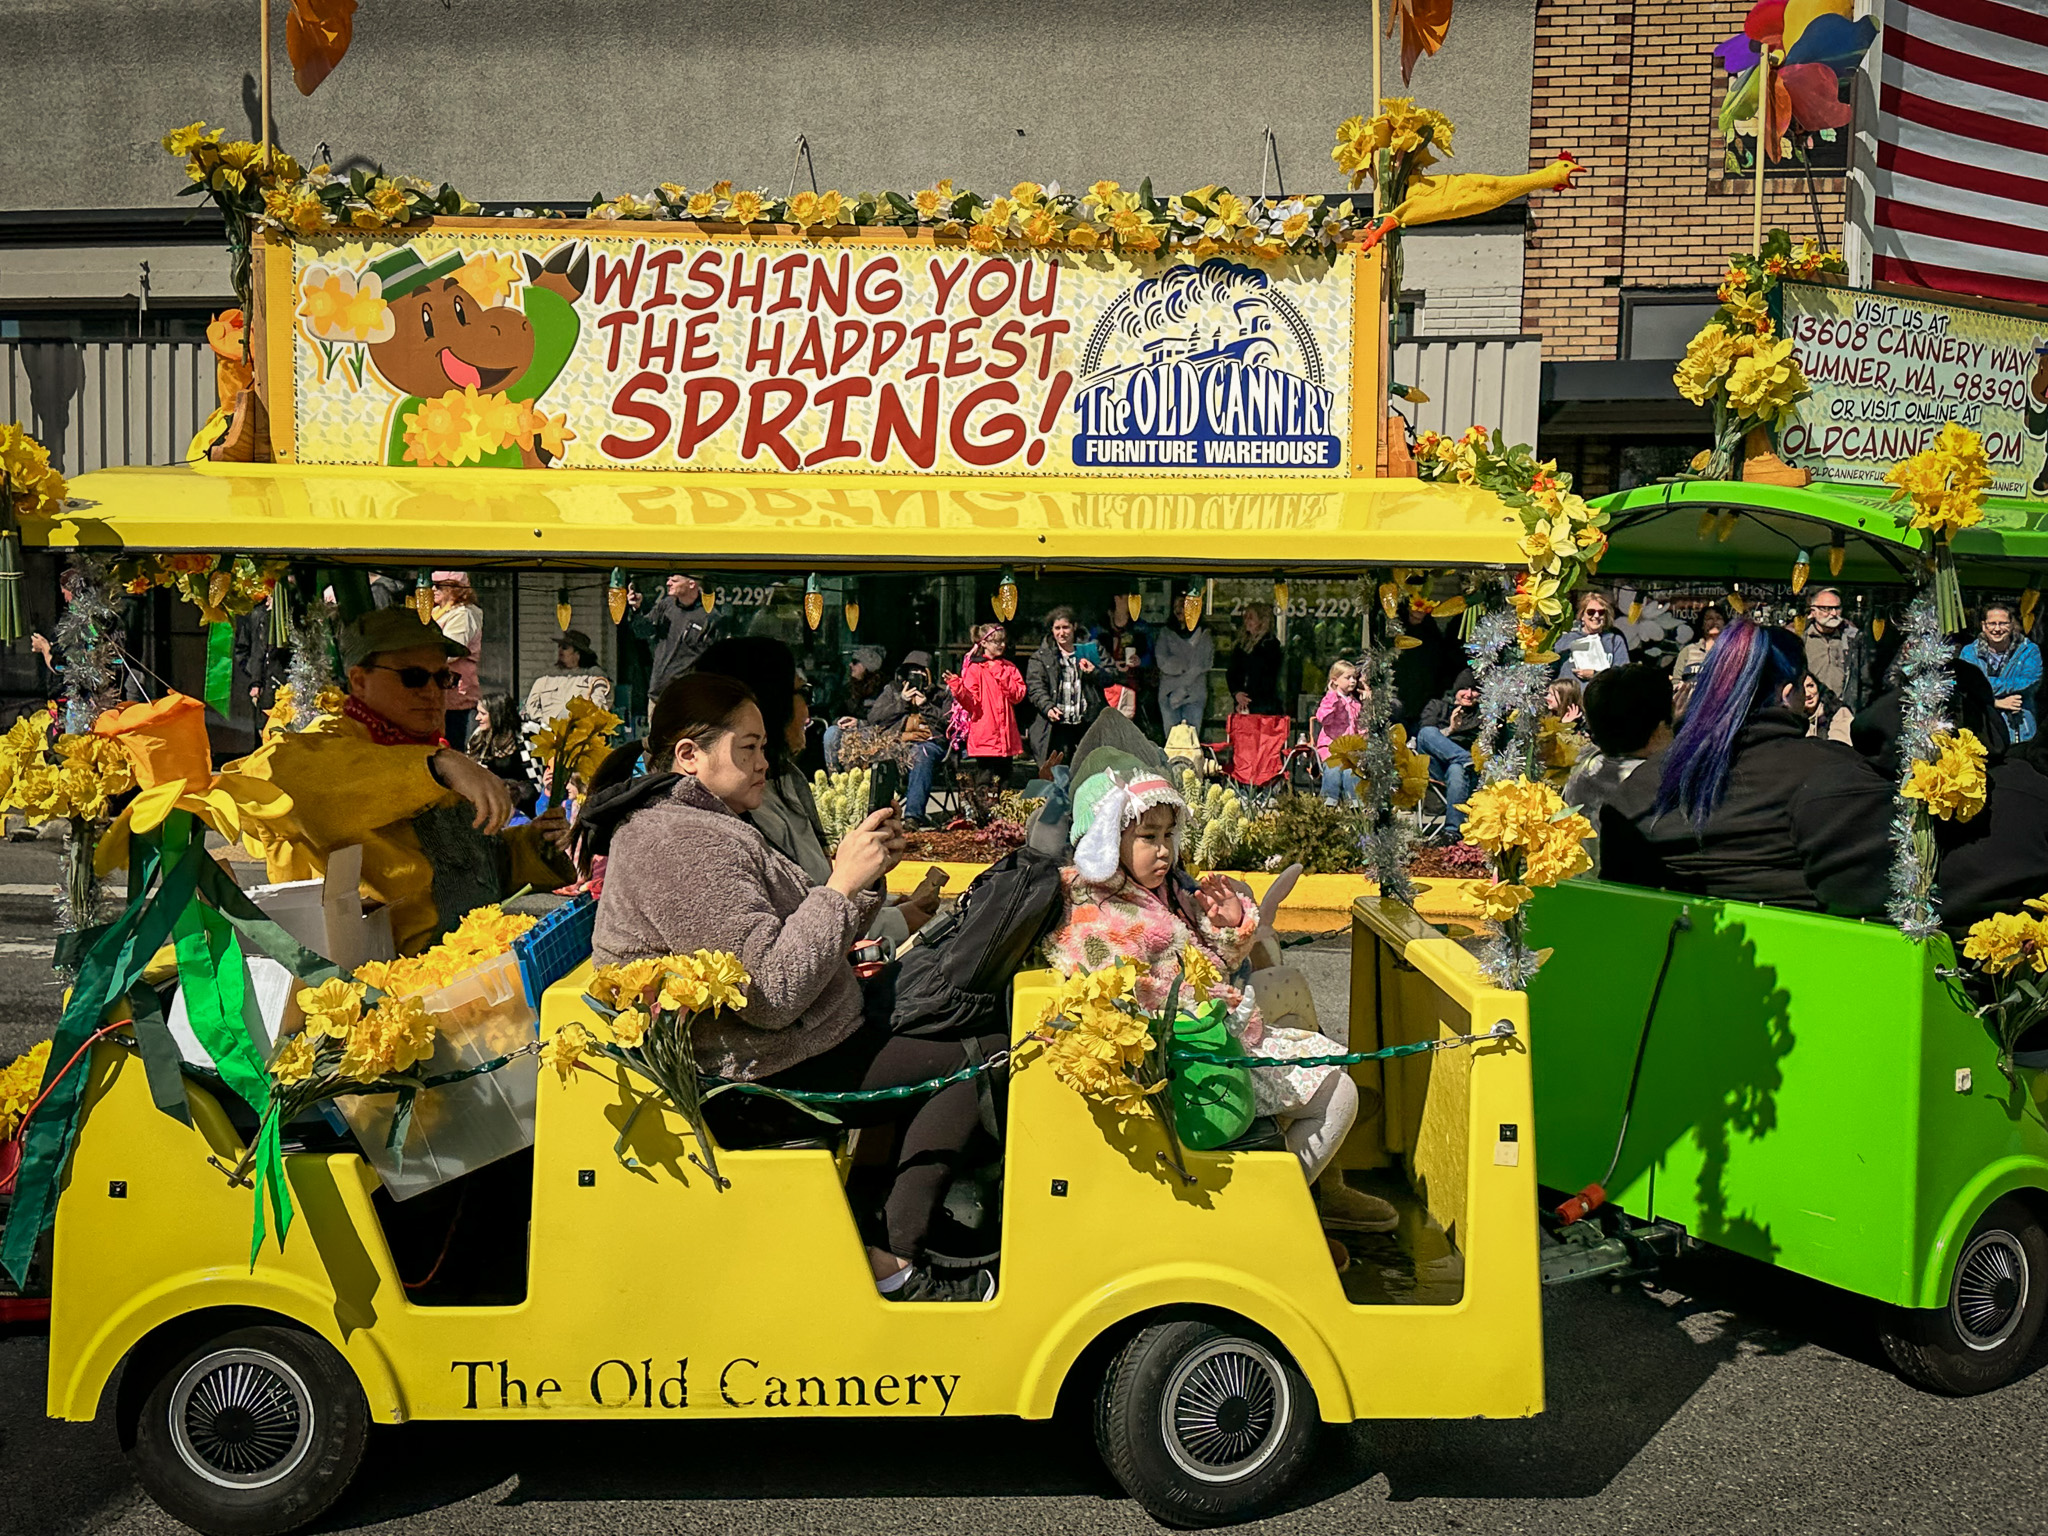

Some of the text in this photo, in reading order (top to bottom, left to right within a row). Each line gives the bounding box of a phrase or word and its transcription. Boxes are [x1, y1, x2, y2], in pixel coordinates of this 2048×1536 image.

[595, 244, 1059, 317] WISHING YOU
[598, 311, 1070, 380] THE HAPPIEST
[1792, 315, 2032, 377] 13608 CANNERY WAY
[1855, 299, 1949, 334] VISIT US AT
[1074, 359, 1334, 436] The OLD CANNERY
[1791, 347, 2027, 407] SUMNER, WA, 98390
[600, 370, 1073, 472] SPRING!
[1830, 399, 1981, 423] OR VISIT ONLINE AT
[1086, 440, 1329, 465] FURNITURE WAREHOUSE
[450, 1356, 961, 1416] The Old Cannery
